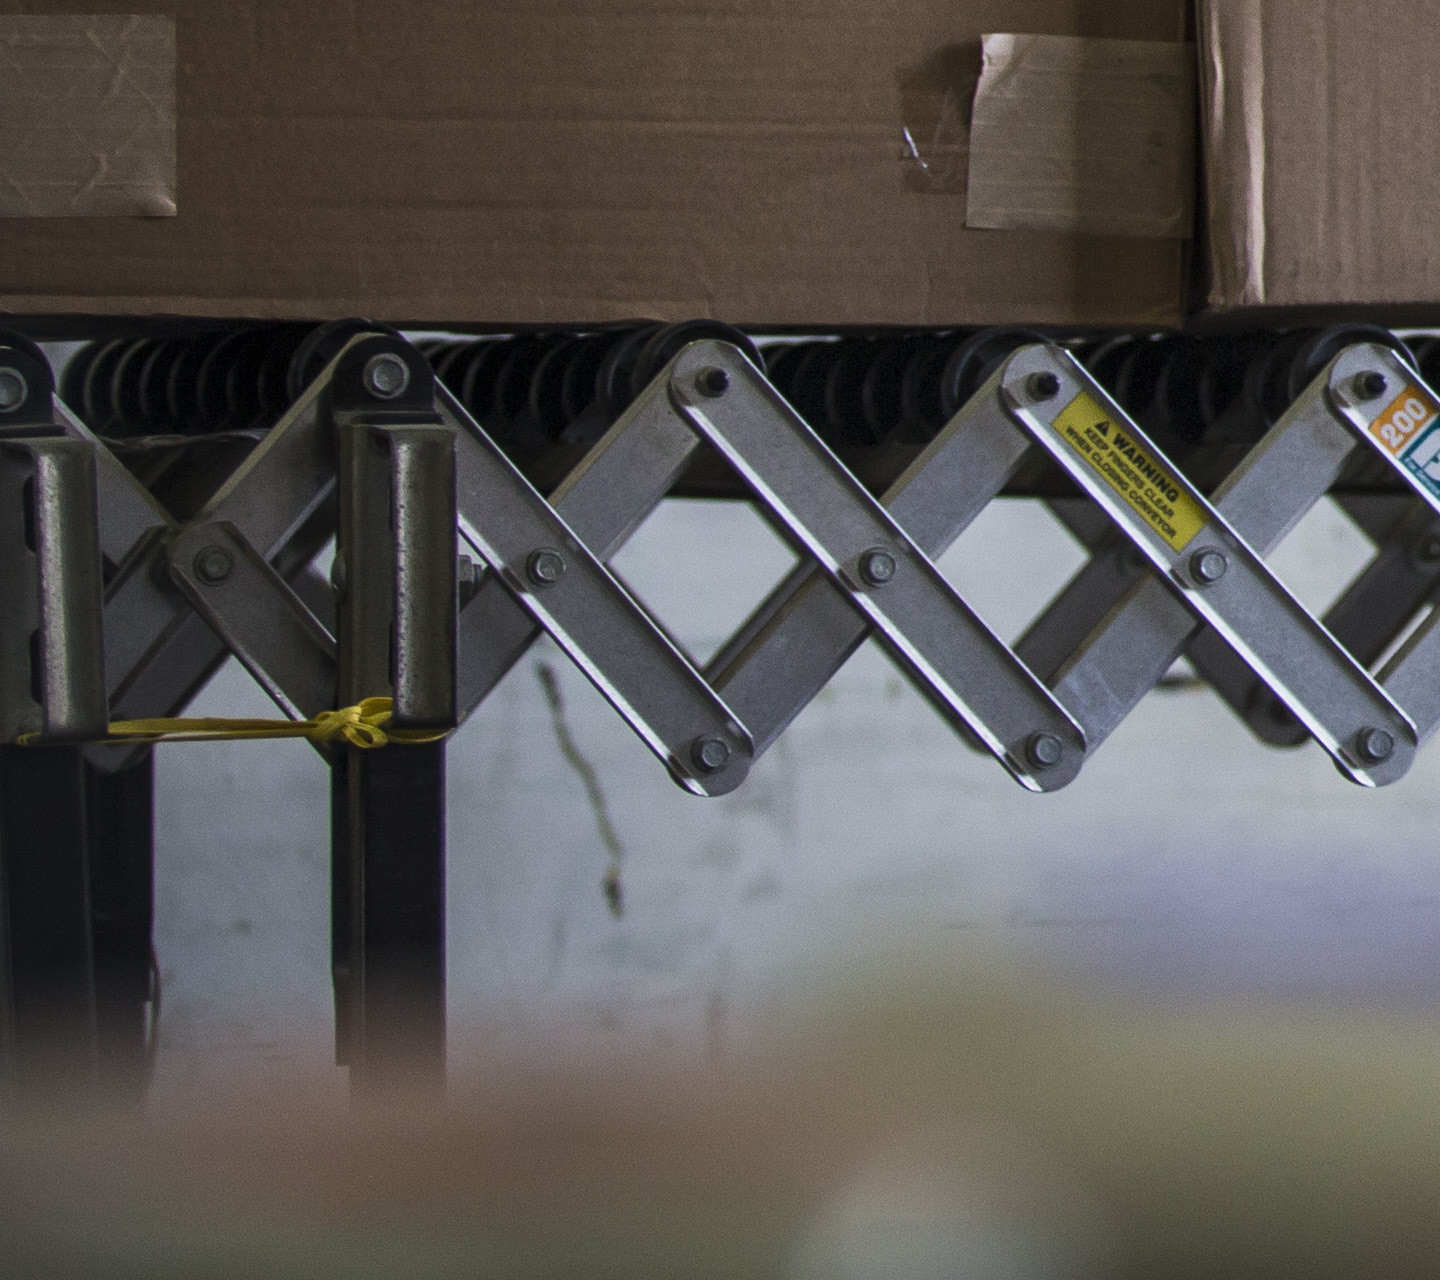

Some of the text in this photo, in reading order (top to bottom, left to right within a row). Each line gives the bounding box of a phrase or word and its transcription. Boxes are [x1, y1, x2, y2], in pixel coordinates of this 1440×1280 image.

[1380, 397, 1428, 448] 200
[1066, 425, 1177, 539] WHEN CLOSING CONVEYOR
[1085, 427, 1175, 518] KEEP FINGERS CLEAR
[1112, 432, 1180, 504] WARNING
